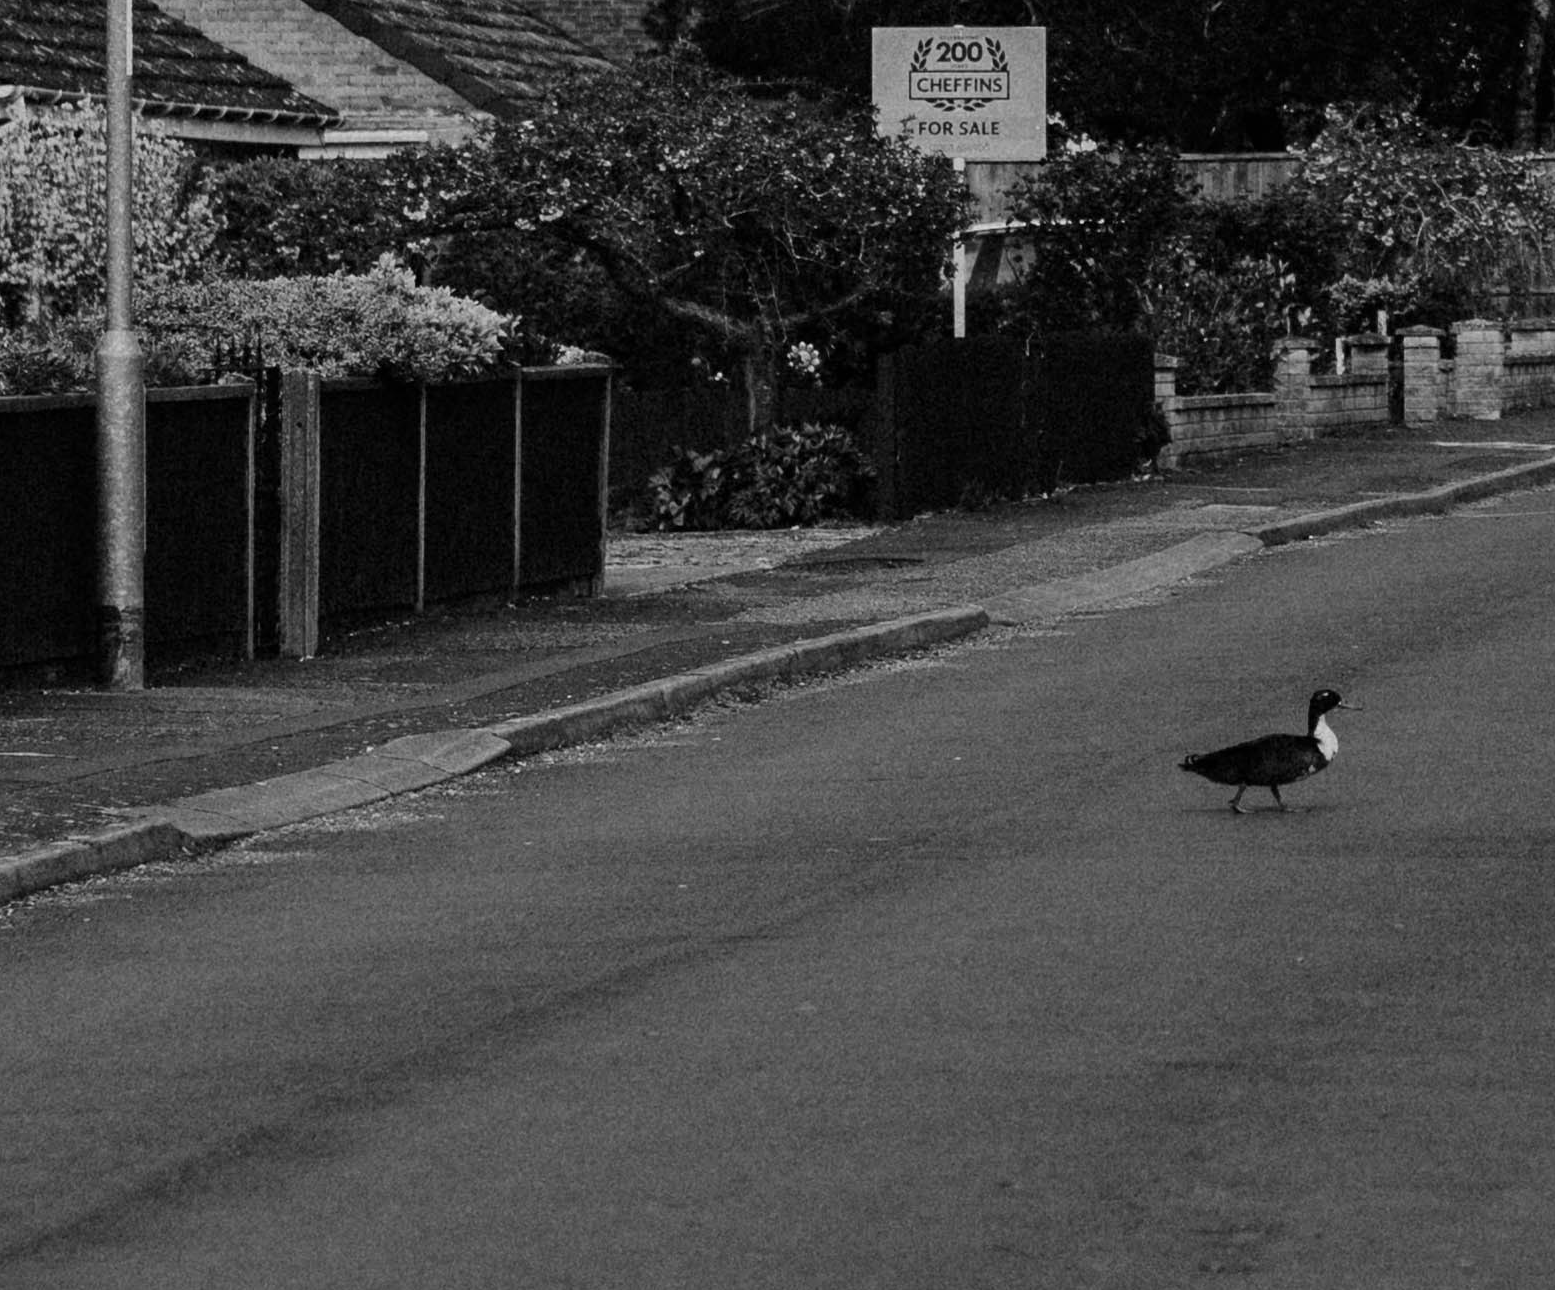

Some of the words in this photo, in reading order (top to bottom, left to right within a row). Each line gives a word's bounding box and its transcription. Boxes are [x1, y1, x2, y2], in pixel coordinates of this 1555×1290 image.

[936, 41, 983, 62] 200
[916, 77, 1003, 92] CHEFFINS
[918, 121, 954, 135] FOR
[959, 121, 1000, 135] SALE
